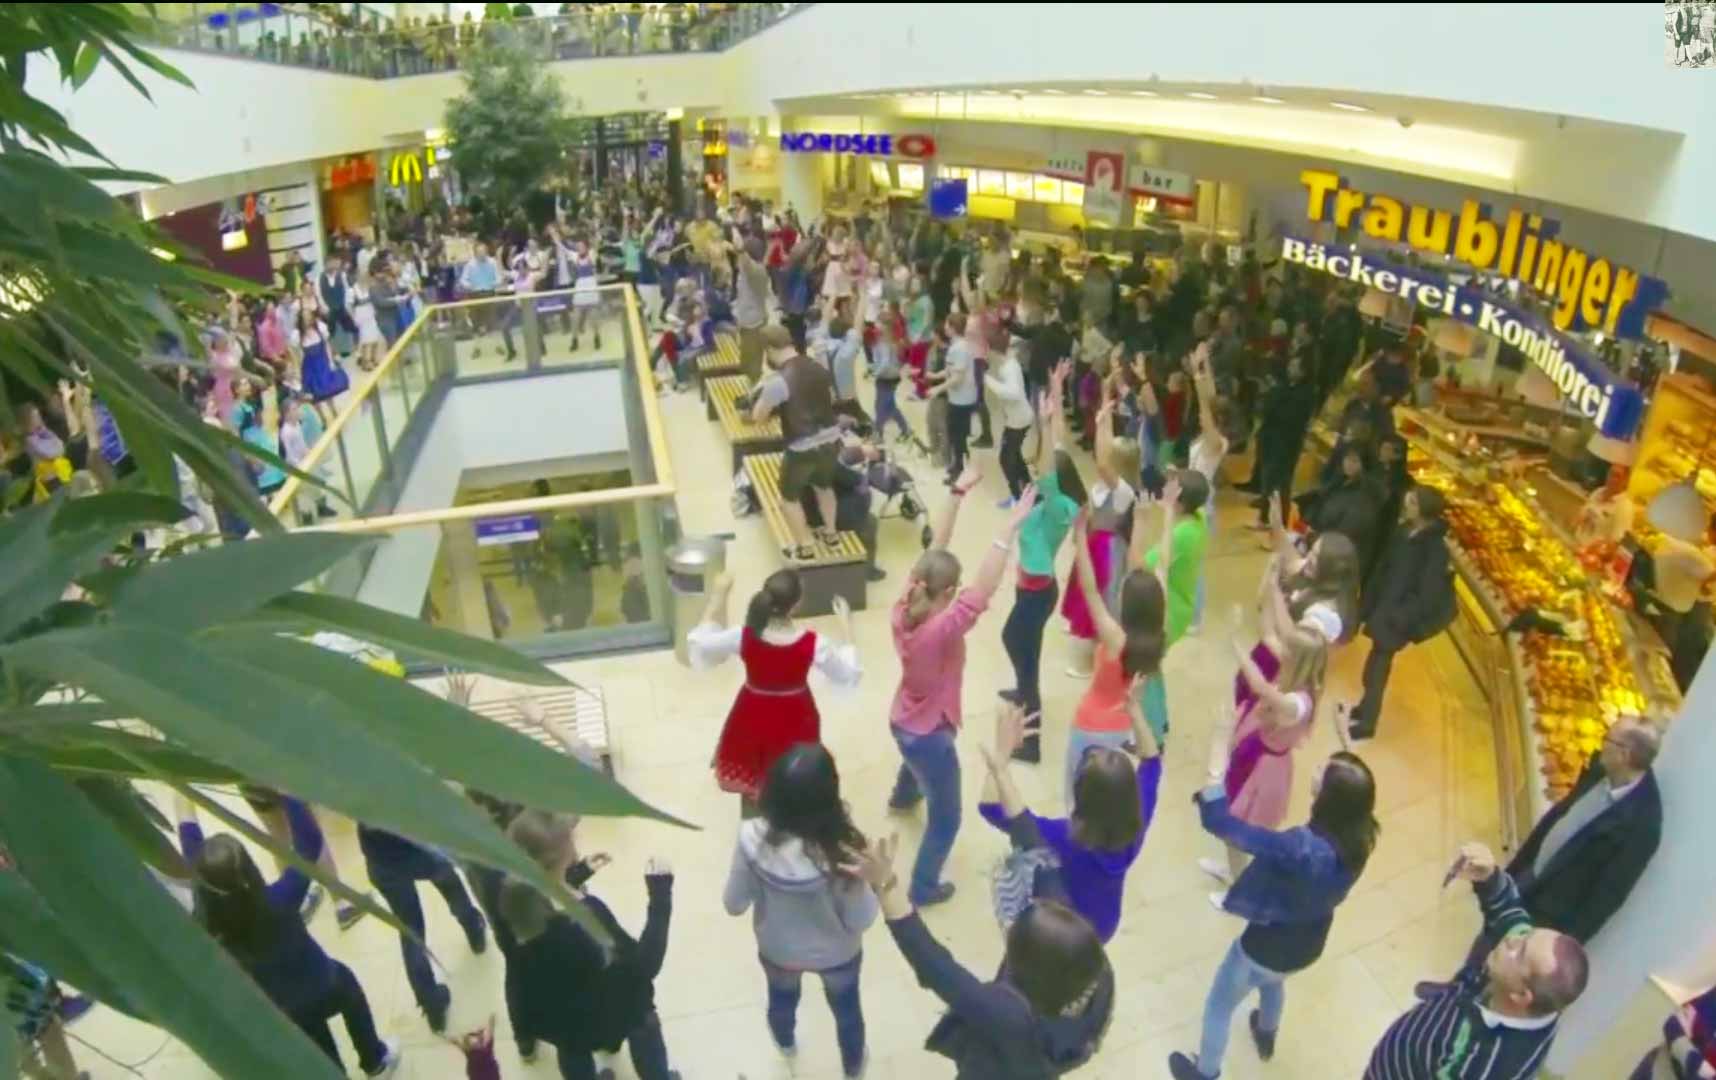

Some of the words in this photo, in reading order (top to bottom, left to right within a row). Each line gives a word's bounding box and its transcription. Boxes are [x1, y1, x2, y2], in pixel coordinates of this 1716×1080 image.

[780, 132, 893, 155] NORDSEE
[1142, 169, 1173, 190] bar
[1301, 168, 1640, 337] Traublinger
[1281, 237, 1458, 316] Bäckerei
[1477, 301, 1614, 433] Konditorei
